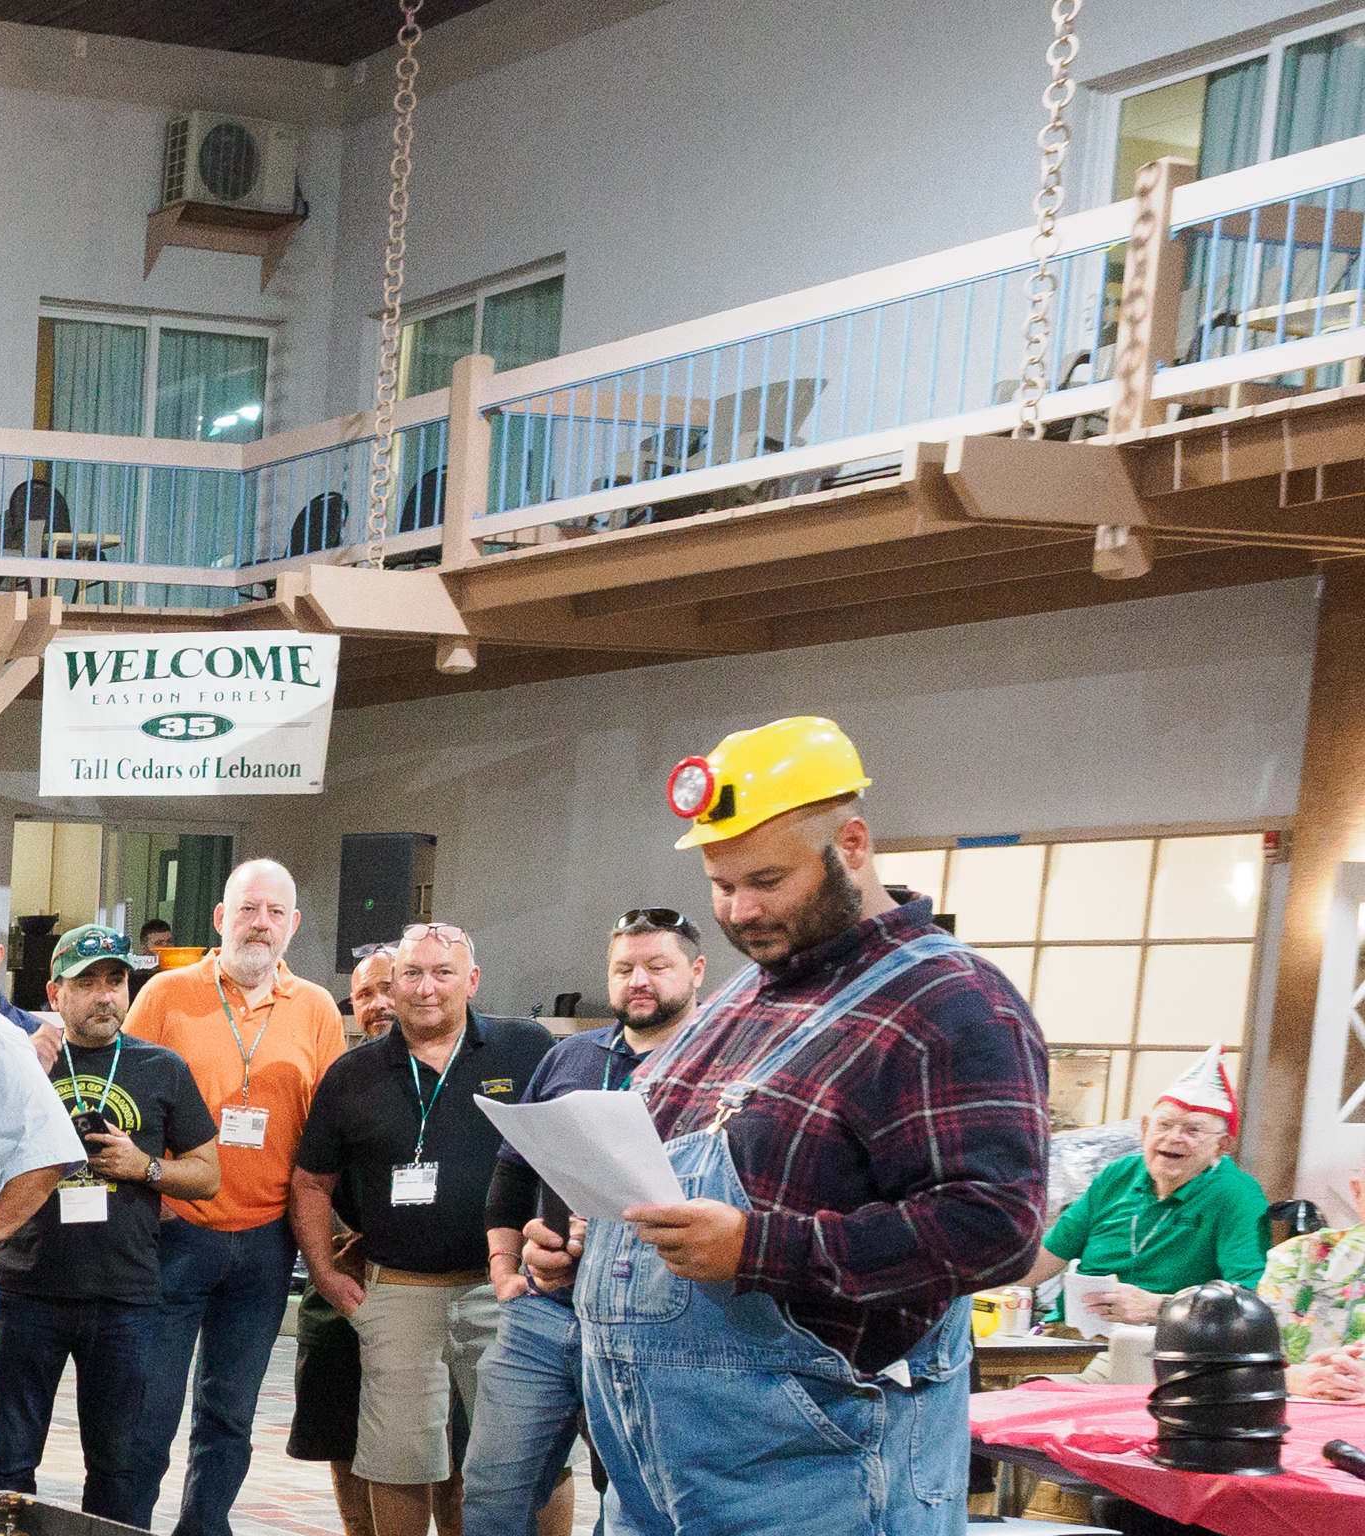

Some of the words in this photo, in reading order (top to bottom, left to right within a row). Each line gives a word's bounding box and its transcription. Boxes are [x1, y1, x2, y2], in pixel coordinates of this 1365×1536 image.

[65, 646, 320, 690] WELCOME
[92, 692, 180, 705] EASTON
[199, 690, 289, 702] FOREST
[158, 716, 216, 737] 35
[70, 758, 108, 780] Tall
[116, 757, 183, 780] Cedars
[189, 756, 211, 779] of
[215, 756, 302, 779] Lebanon
